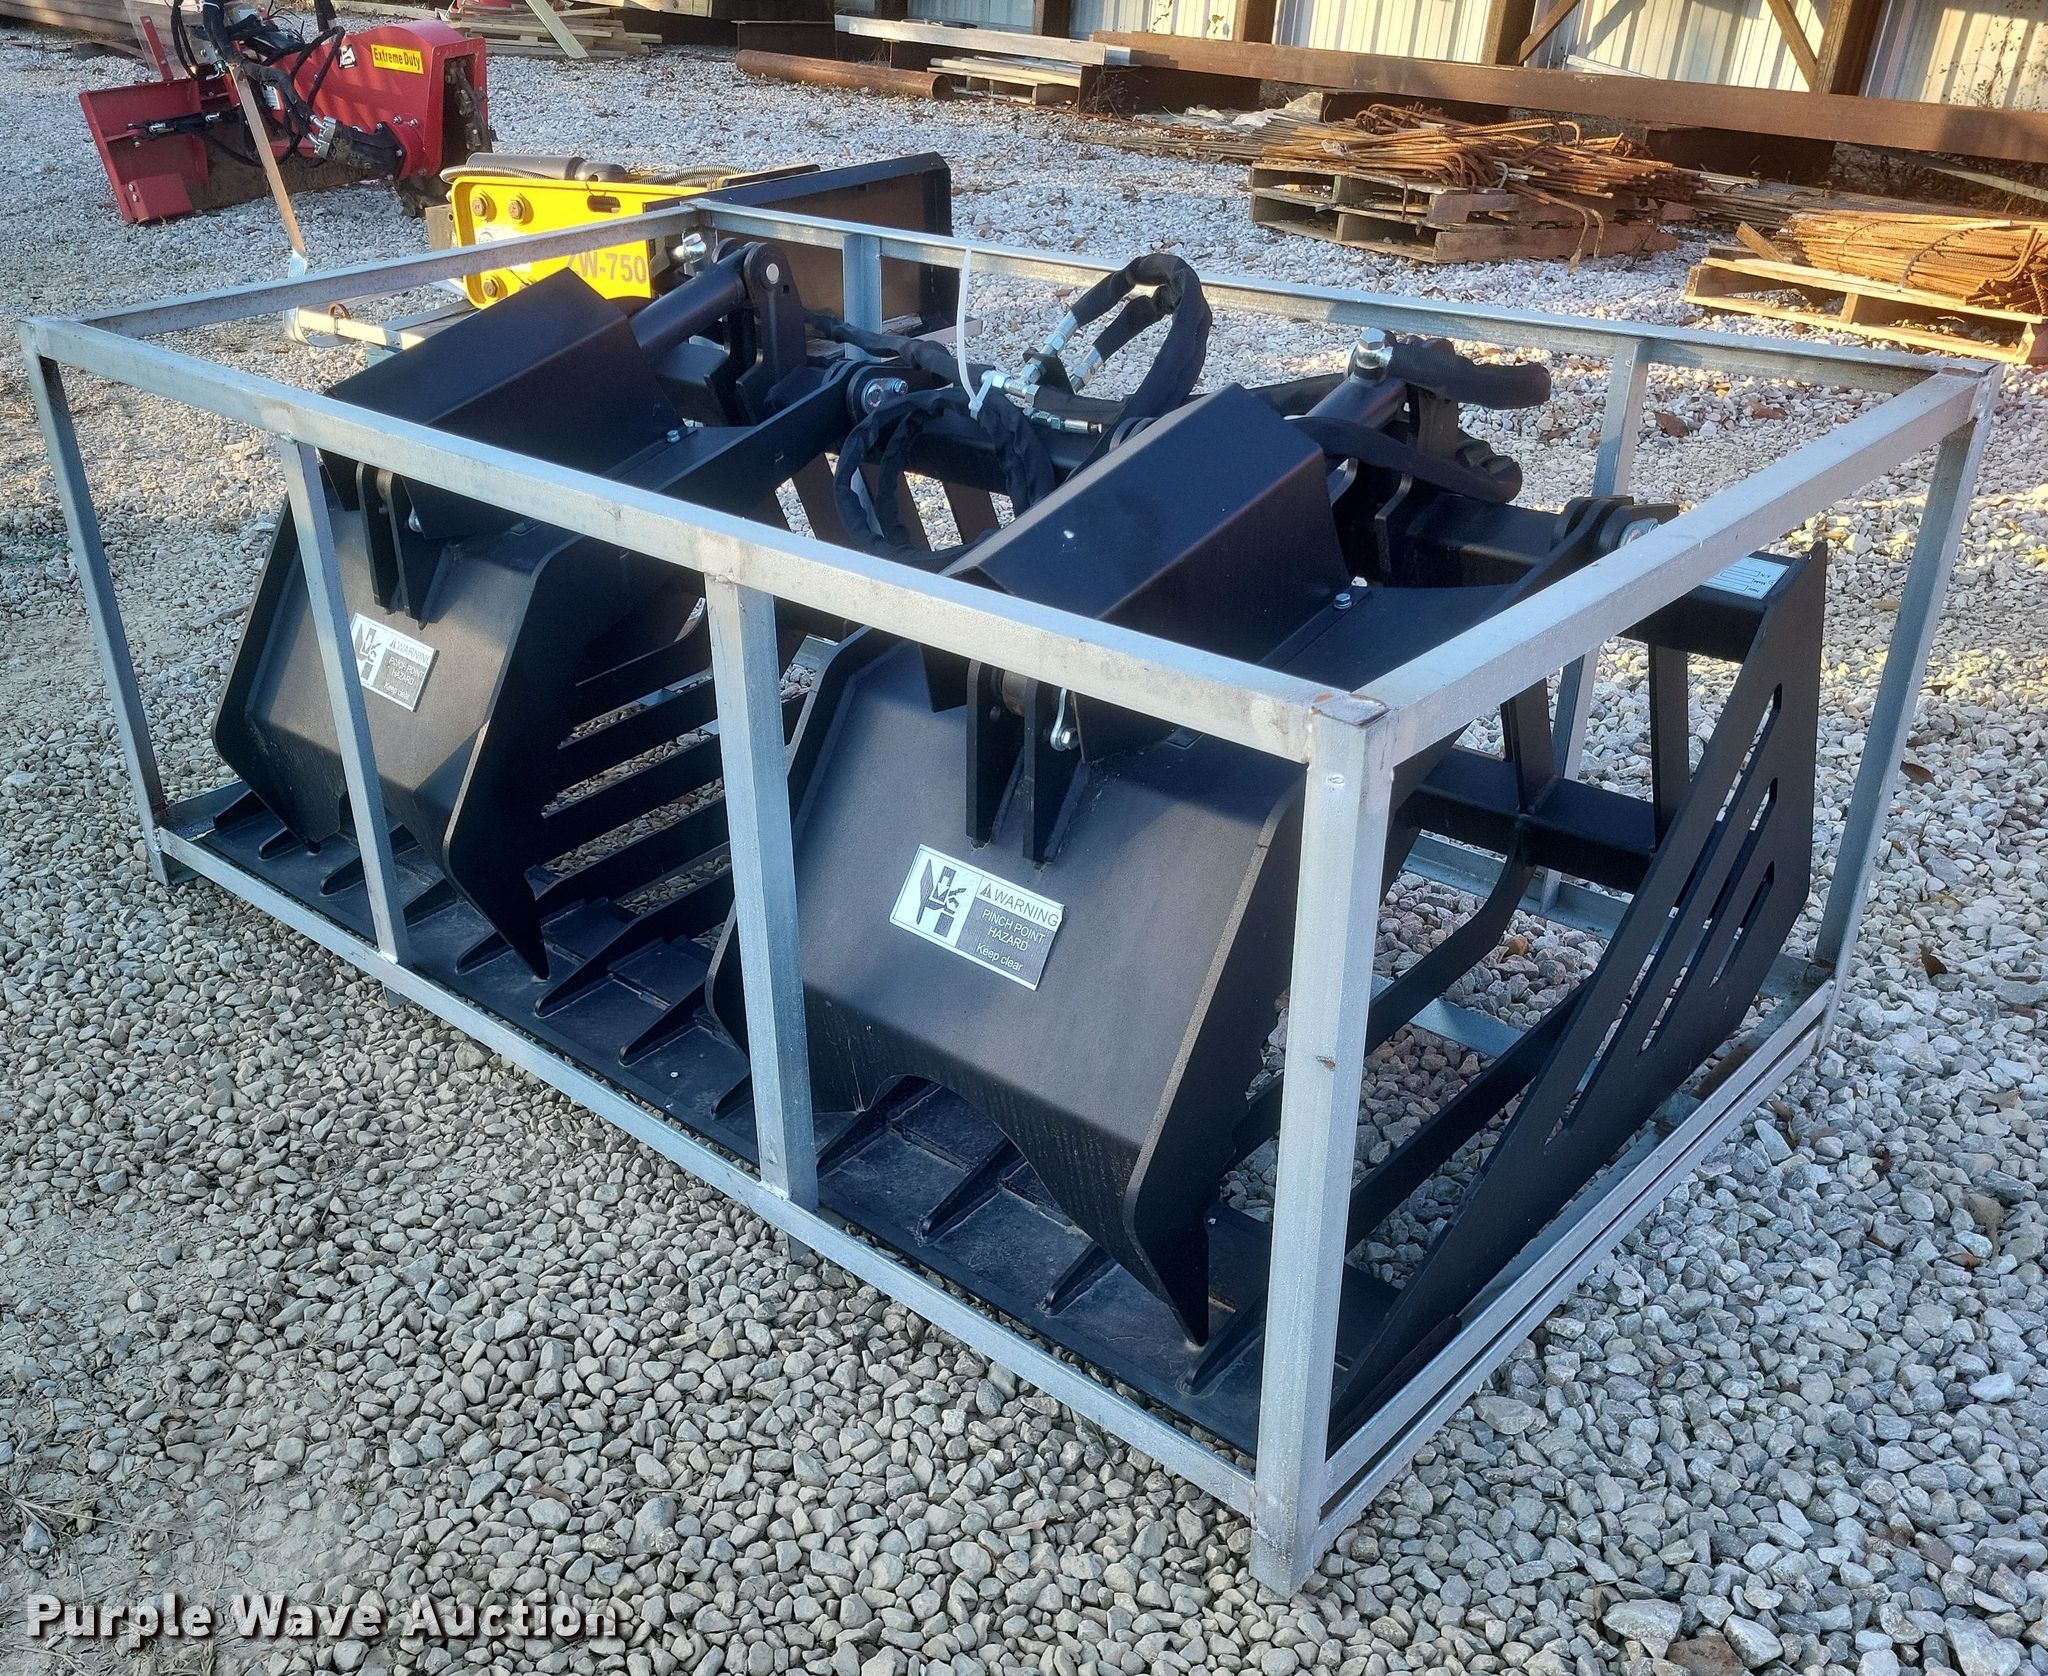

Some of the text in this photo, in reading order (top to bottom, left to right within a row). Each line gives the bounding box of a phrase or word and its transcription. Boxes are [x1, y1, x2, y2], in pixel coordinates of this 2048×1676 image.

[373, 48, 420, 70] Extreme Duty
[391, 669, 415, 685] HAZARD
[405, 664, 425, 679] POINT
[383, 681, 398, 695] Keep
[994, 889, 1059, 927] WARNING
[982, 908, 1046, 944] PINCH POINT
[987, 926, 1028, 951] HAZARD
[976, 943, 1023, 971] Keep clear
